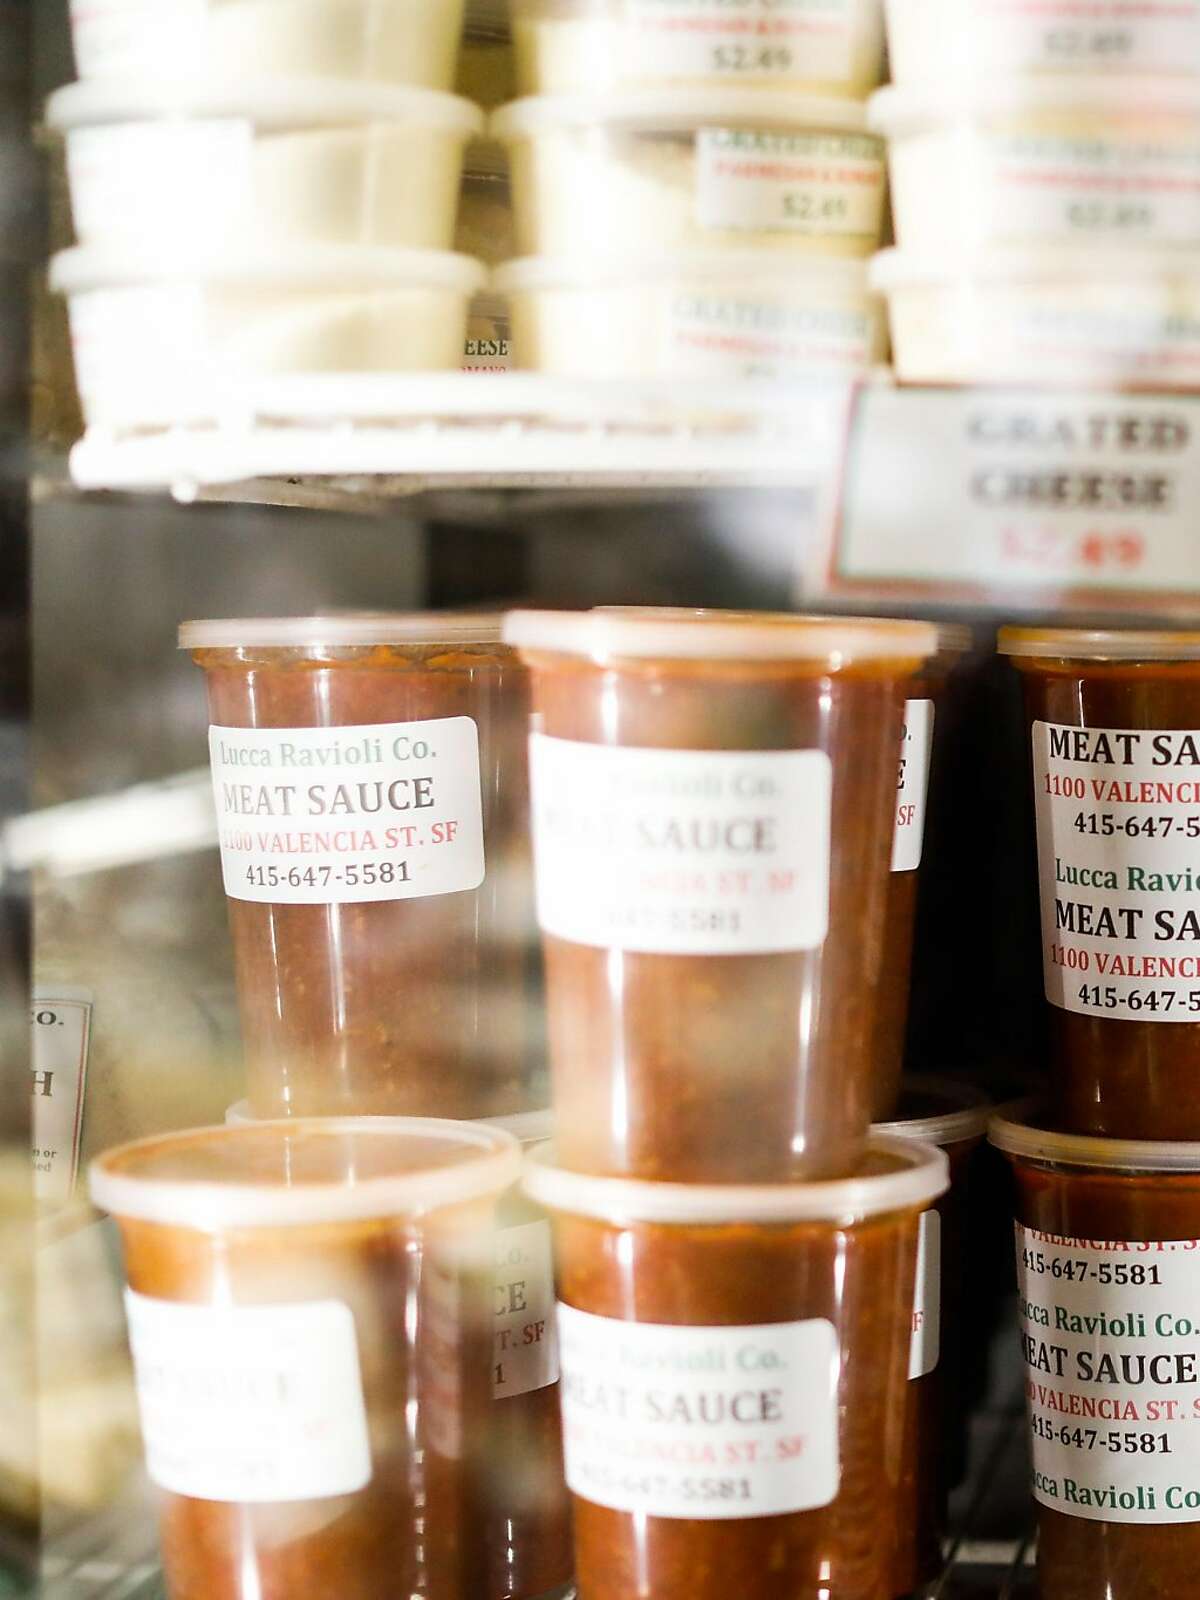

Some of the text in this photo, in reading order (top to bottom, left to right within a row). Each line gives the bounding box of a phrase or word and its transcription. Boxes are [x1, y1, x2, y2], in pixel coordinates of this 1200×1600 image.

[966, 412, 1190, 452] GRATED
[968, 464, 1172, 507] CHEESE
[220, 737, 437, 767] Lucca Ravioli Co.
[1049, 727, 1140, 765] MEAT
[222, 777, 435, 816] MEAT SAUCE
[1043, 772, 1086, 799] 1100
[897, 805, 916, 826] SF
[258, 829, 378, 853] VALENCIA
[384, 826, 424, 849] ST.
[431, 820, 459, 844] SF
[636, 814, 778, 852] SAUCE
[246, 860, 412, 887] 415-647-5581
[1055, 857, 1119, 890] Lucca
[1055, 898, 1143, 940] MEAT
[1050, 943, 1089, 971] 1100
[1023, 1248, 1162, 1285] 415-647-5581
[523, 1320, 545, 1345] SF
[1055, 1305, 1145, 1337] Ravioli
[1155, 1314, 1200, 1338] Co.
[736, 1342, 788, 1371] Co.
[1076, 1351, 1197, 1384] SAUCE
[646, 1388, 784, 1425] SAUCE
[1039, 1385, 1139, 1421] VALENCIA
[1146, 1400, 1185, 1420] ST.
[1032, 1413, 1172, 1453] 415-647-5581
[1064, 1478, 1155, 1510] Ravioli
